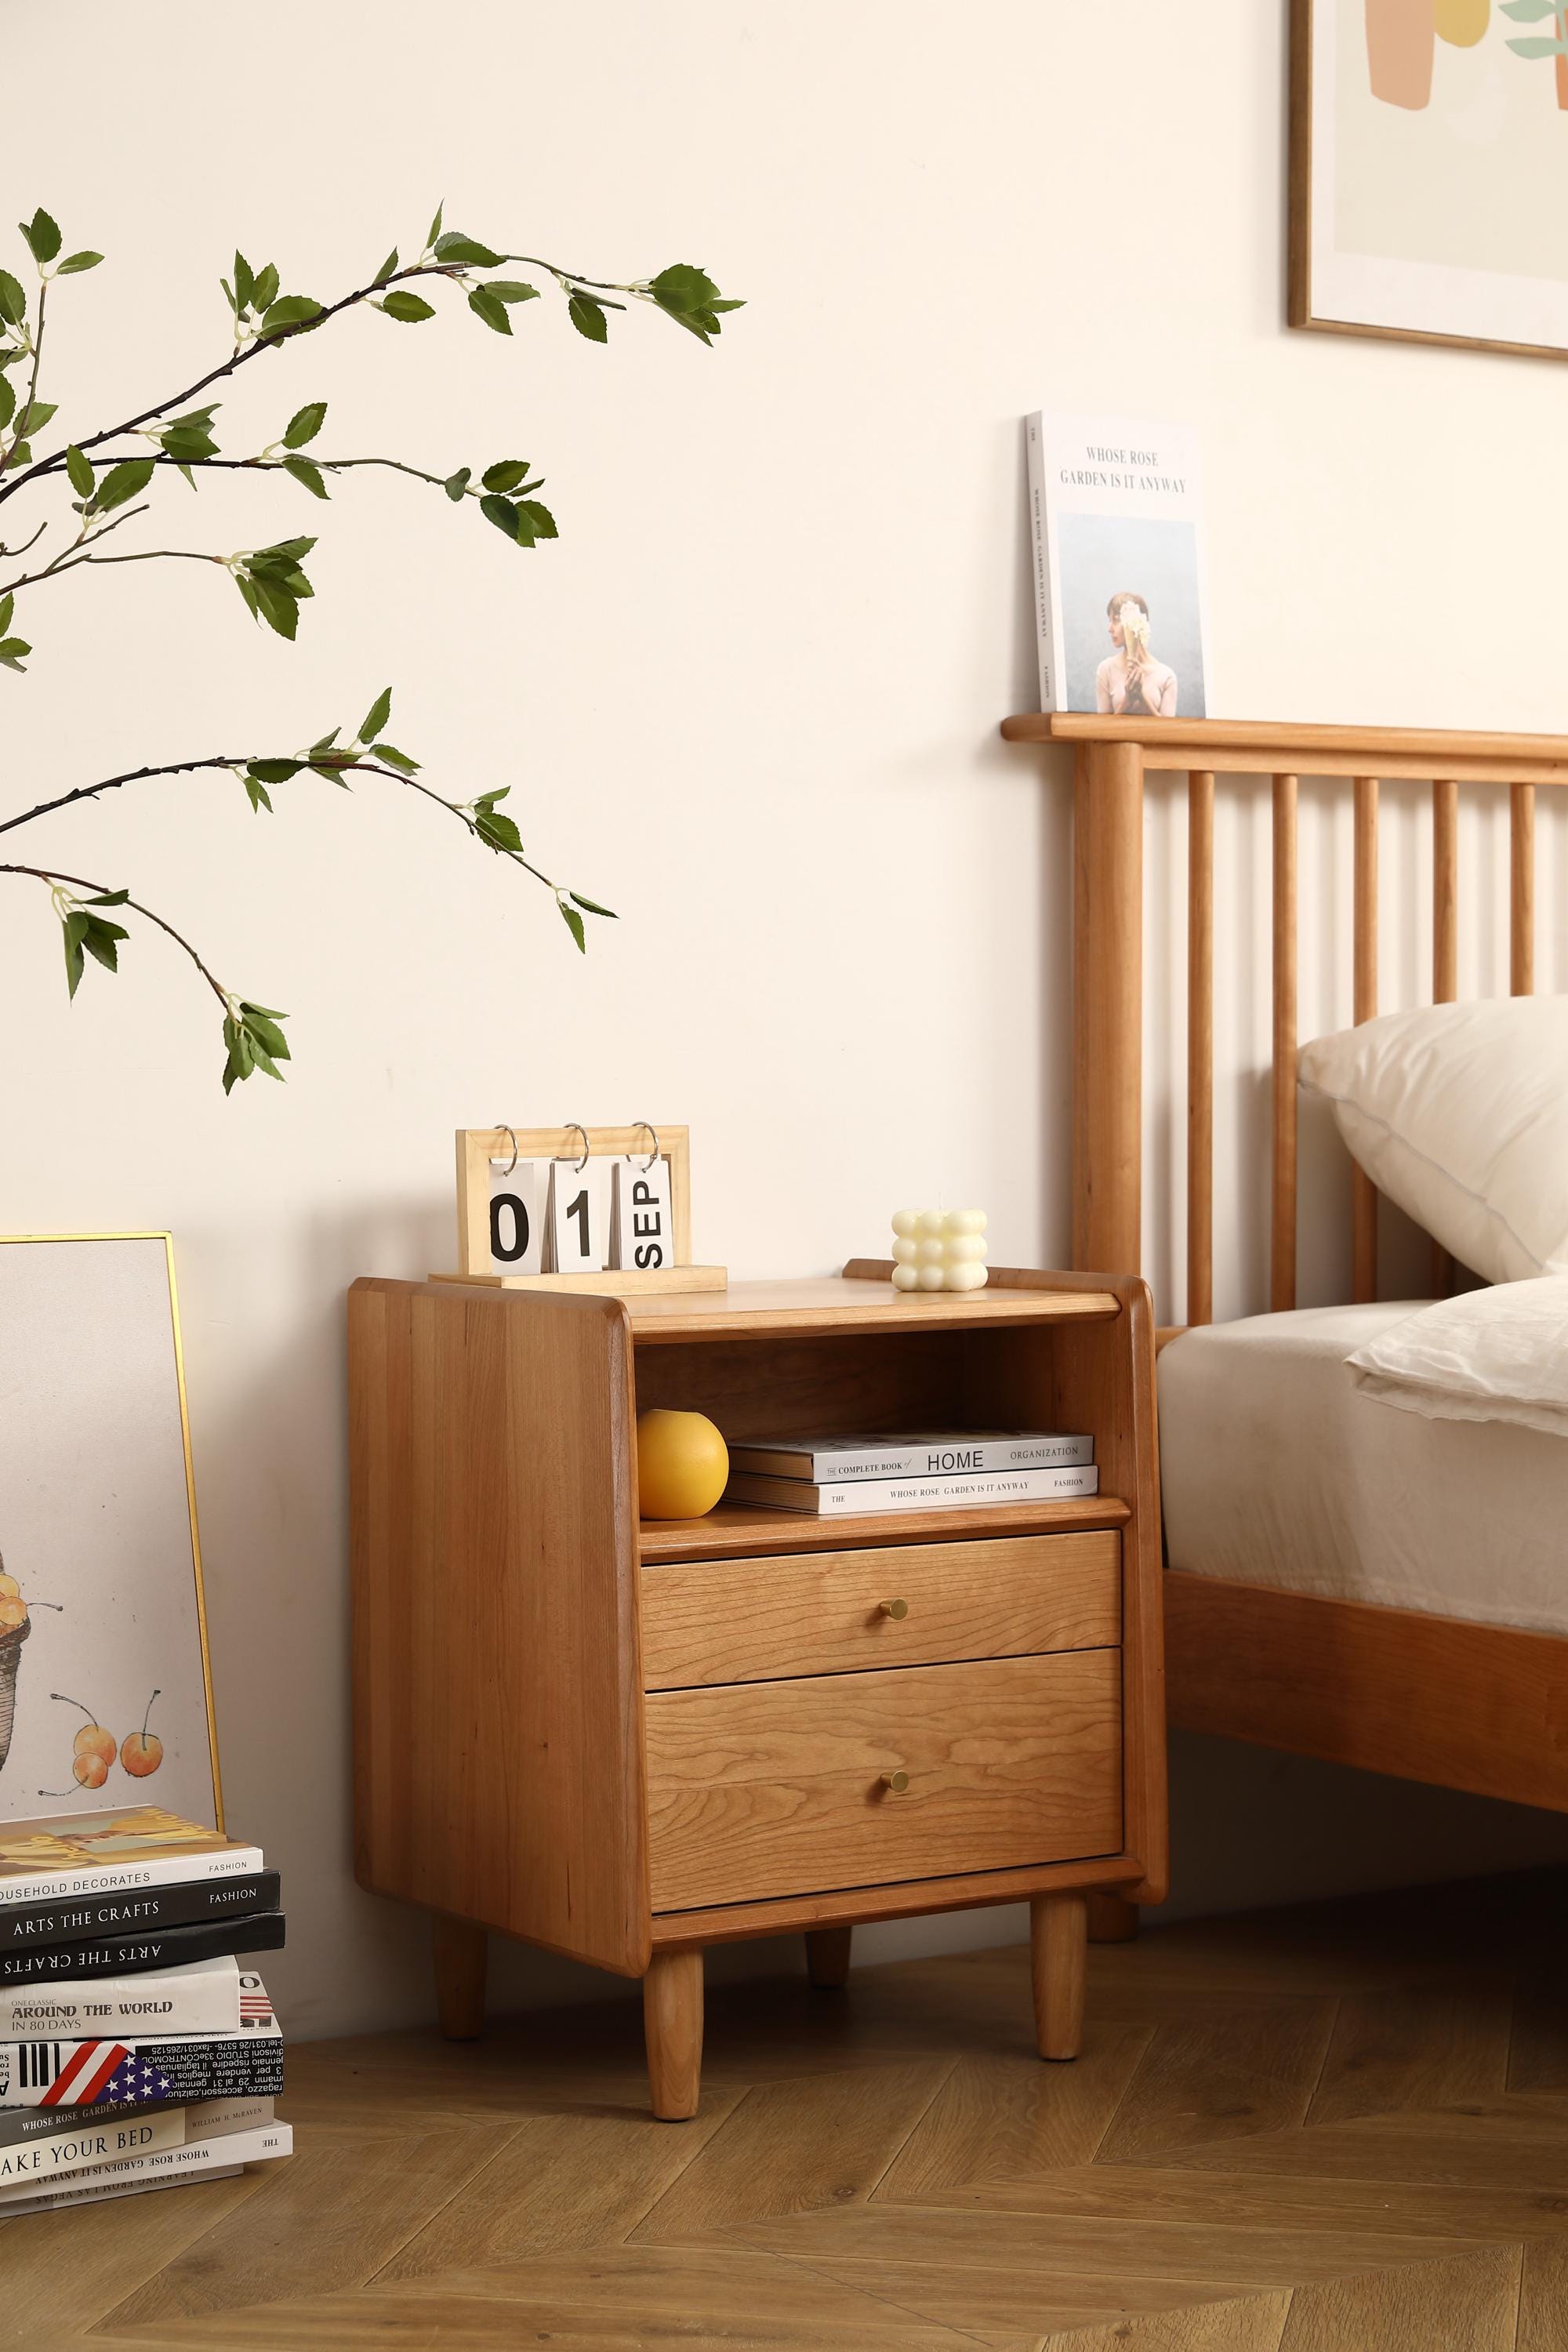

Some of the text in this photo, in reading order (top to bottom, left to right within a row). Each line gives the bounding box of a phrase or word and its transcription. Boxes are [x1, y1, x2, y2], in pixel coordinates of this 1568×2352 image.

[1087, 446, 1159, 466] WHOSE ROSE
[1060, 469, 1186, 494] GARDEN IS IT ANYWAY
[632, 1180, 663, 1269] SEP
[1010, 1446, 1079, 1460] ORGANIZATION
[838, 1464, 880, 1475] COMPLETE
[881, 1461, 903, 1472] BOOK
[927, 1450, 984, 1472] HOME
[890, 1481, 1029, 1499] WHOSE ROSE GARDEN IS IT ANYWAY
[1054, 1478, 1083, 1487] FASHION
[832, 1495, 846, 1504] THE
[209, 1860, 248, 1873] FASHION
[73, 1872, 151, 1891] DECORATES
[209, 1888, 257, 1904] FASHION
[13, 1900, 160, 1936] ARTS THE CRAFTS
[4, 1944, 162, 1974] ARTS THE CRAFTS
[12, 2002, 173, 2019] AROUND THE WORLD
[12, 2019, 82, 2031] IN 80 DAYS
[252, 2048, 283, 2058] divisoni
[212, 2057, 250, 2070] rispedire
[256, 2065, 271, 2075] per
[275, 2066, 282, 2075] 3
[176, 2070, 211, 2080] meglios
[216, 2067, 252, 2076] vendere
[212, 2078, 223, 2088] 31
[225, 2078, 233, 2087] al
[238, 2078, 249, 2086] 29
[22, 2116, 53, 2132] WHOSE
[56, 2111, 78, 2125] ROSE
[82, 2103, 118, 2118] GARDEN
[191, 2116, 220, 2128] WILLIAM
[233, 2107, 263, 2119] McRAVEN
[50, 2137, 108, 2164] YOUR
[117, 2127, 153, 2150] BED
[35, 2138, 278, 2185] THE WHOSE ROSE GARDEN IS IT ANYWAY
